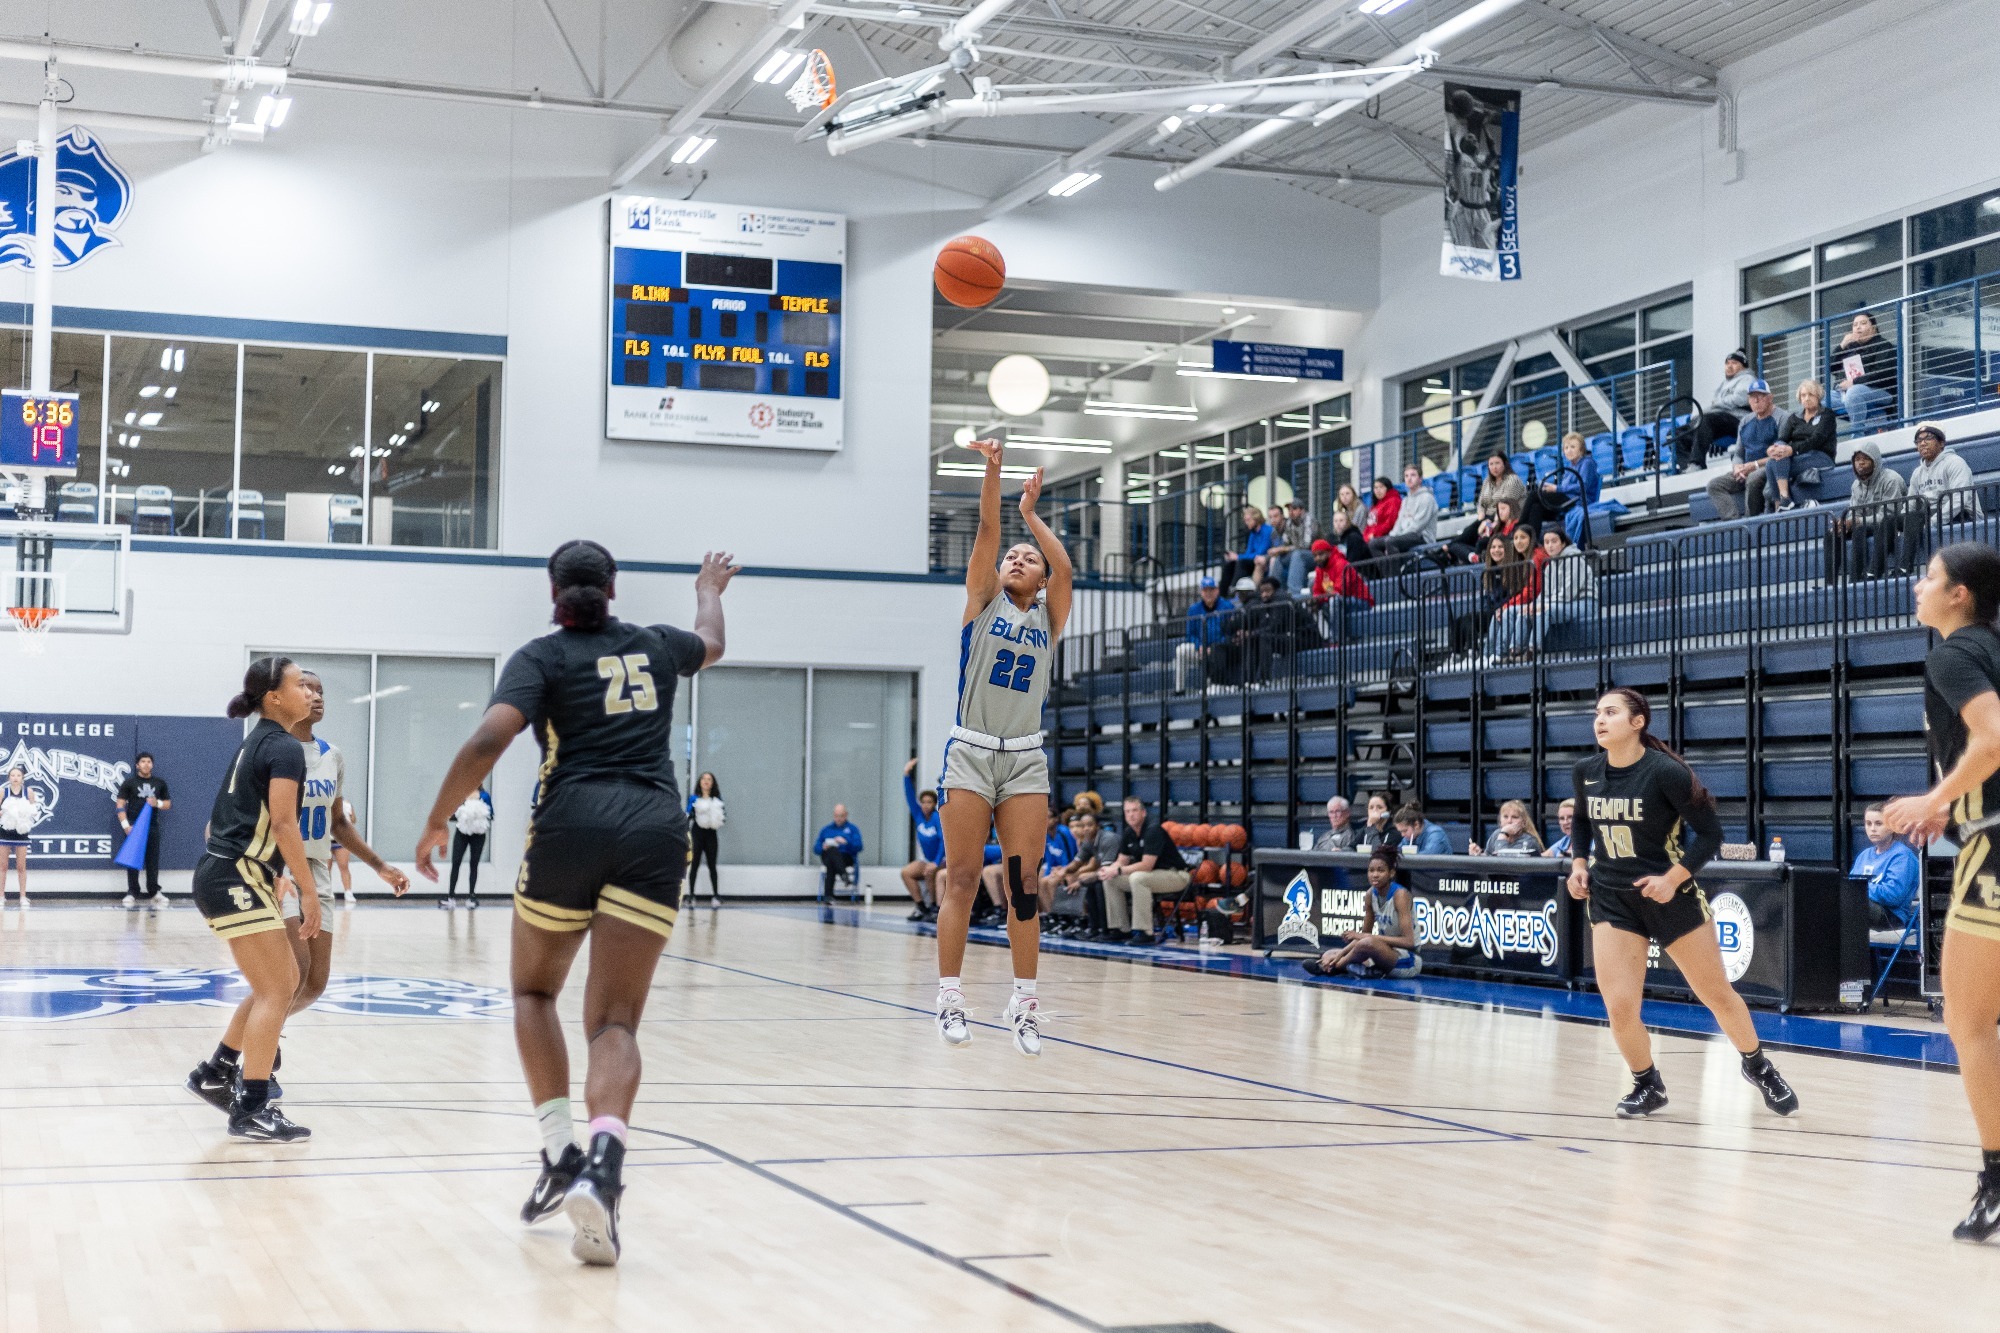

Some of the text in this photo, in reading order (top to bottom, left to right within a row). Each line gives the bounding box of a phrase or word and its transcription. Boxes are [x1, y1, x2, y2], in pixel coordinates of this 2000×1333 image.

[1503, 254, 1517, 279] 3
[712, 299, 747, 312] PERIOD
[781, 296, 829, 314] TEMPLE
[625, 340, 650, 357] FLS
[694, 344, 764, 363] PLYR FOUL
[805, 352, 830, 367] FLS
[23, 400, 73, 425] 6:36
[33, 425, 63, 460] 19
[989, 616, 1048, 651] BLINN
[989, 648, 1036, 693] 22
[598, 653, 658, 715] 25
[18, 722, 114, 737] COLLEGE
[0, 738, 131, 803] ANEERS
[1588, 796, 1643, 821] TEMPLE
[301, 805, 326, 841] 10
[1599, 825, 1637, 859] 10
[1439, 878, 1520, 895] BLINN COLLEGE
[1413, 895, 1558, 967] BUCCANEERS
